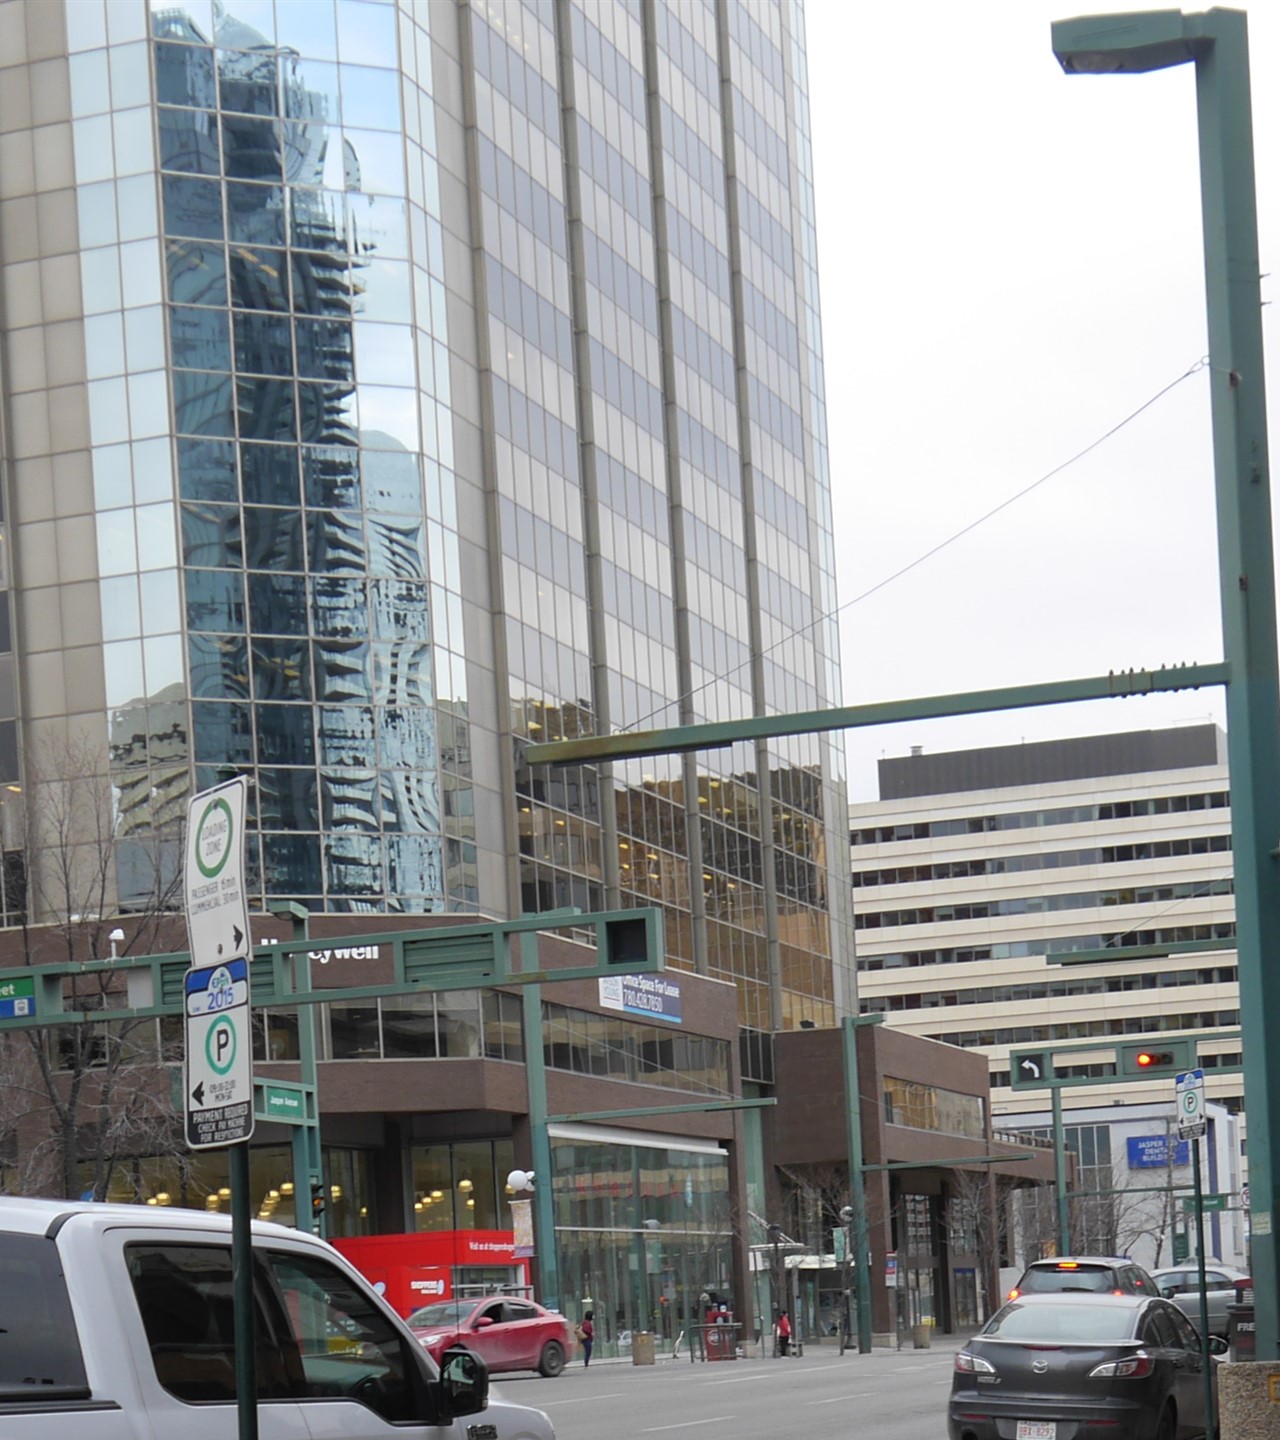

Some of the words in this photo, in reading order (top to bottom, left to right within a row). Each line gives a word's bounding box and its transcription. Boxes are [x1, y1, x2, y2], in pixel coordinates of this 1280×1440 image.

[201, 818, 227, 841] LOADING
[205, 837, 222, 857] ZONE
[207, 987, 234, 1010] 2015
[216, 1028, 229, 1062] P
[193, 1109, 223, 1124] PAYMENT
[1138, 1140, 1163, 1148] JASPER
